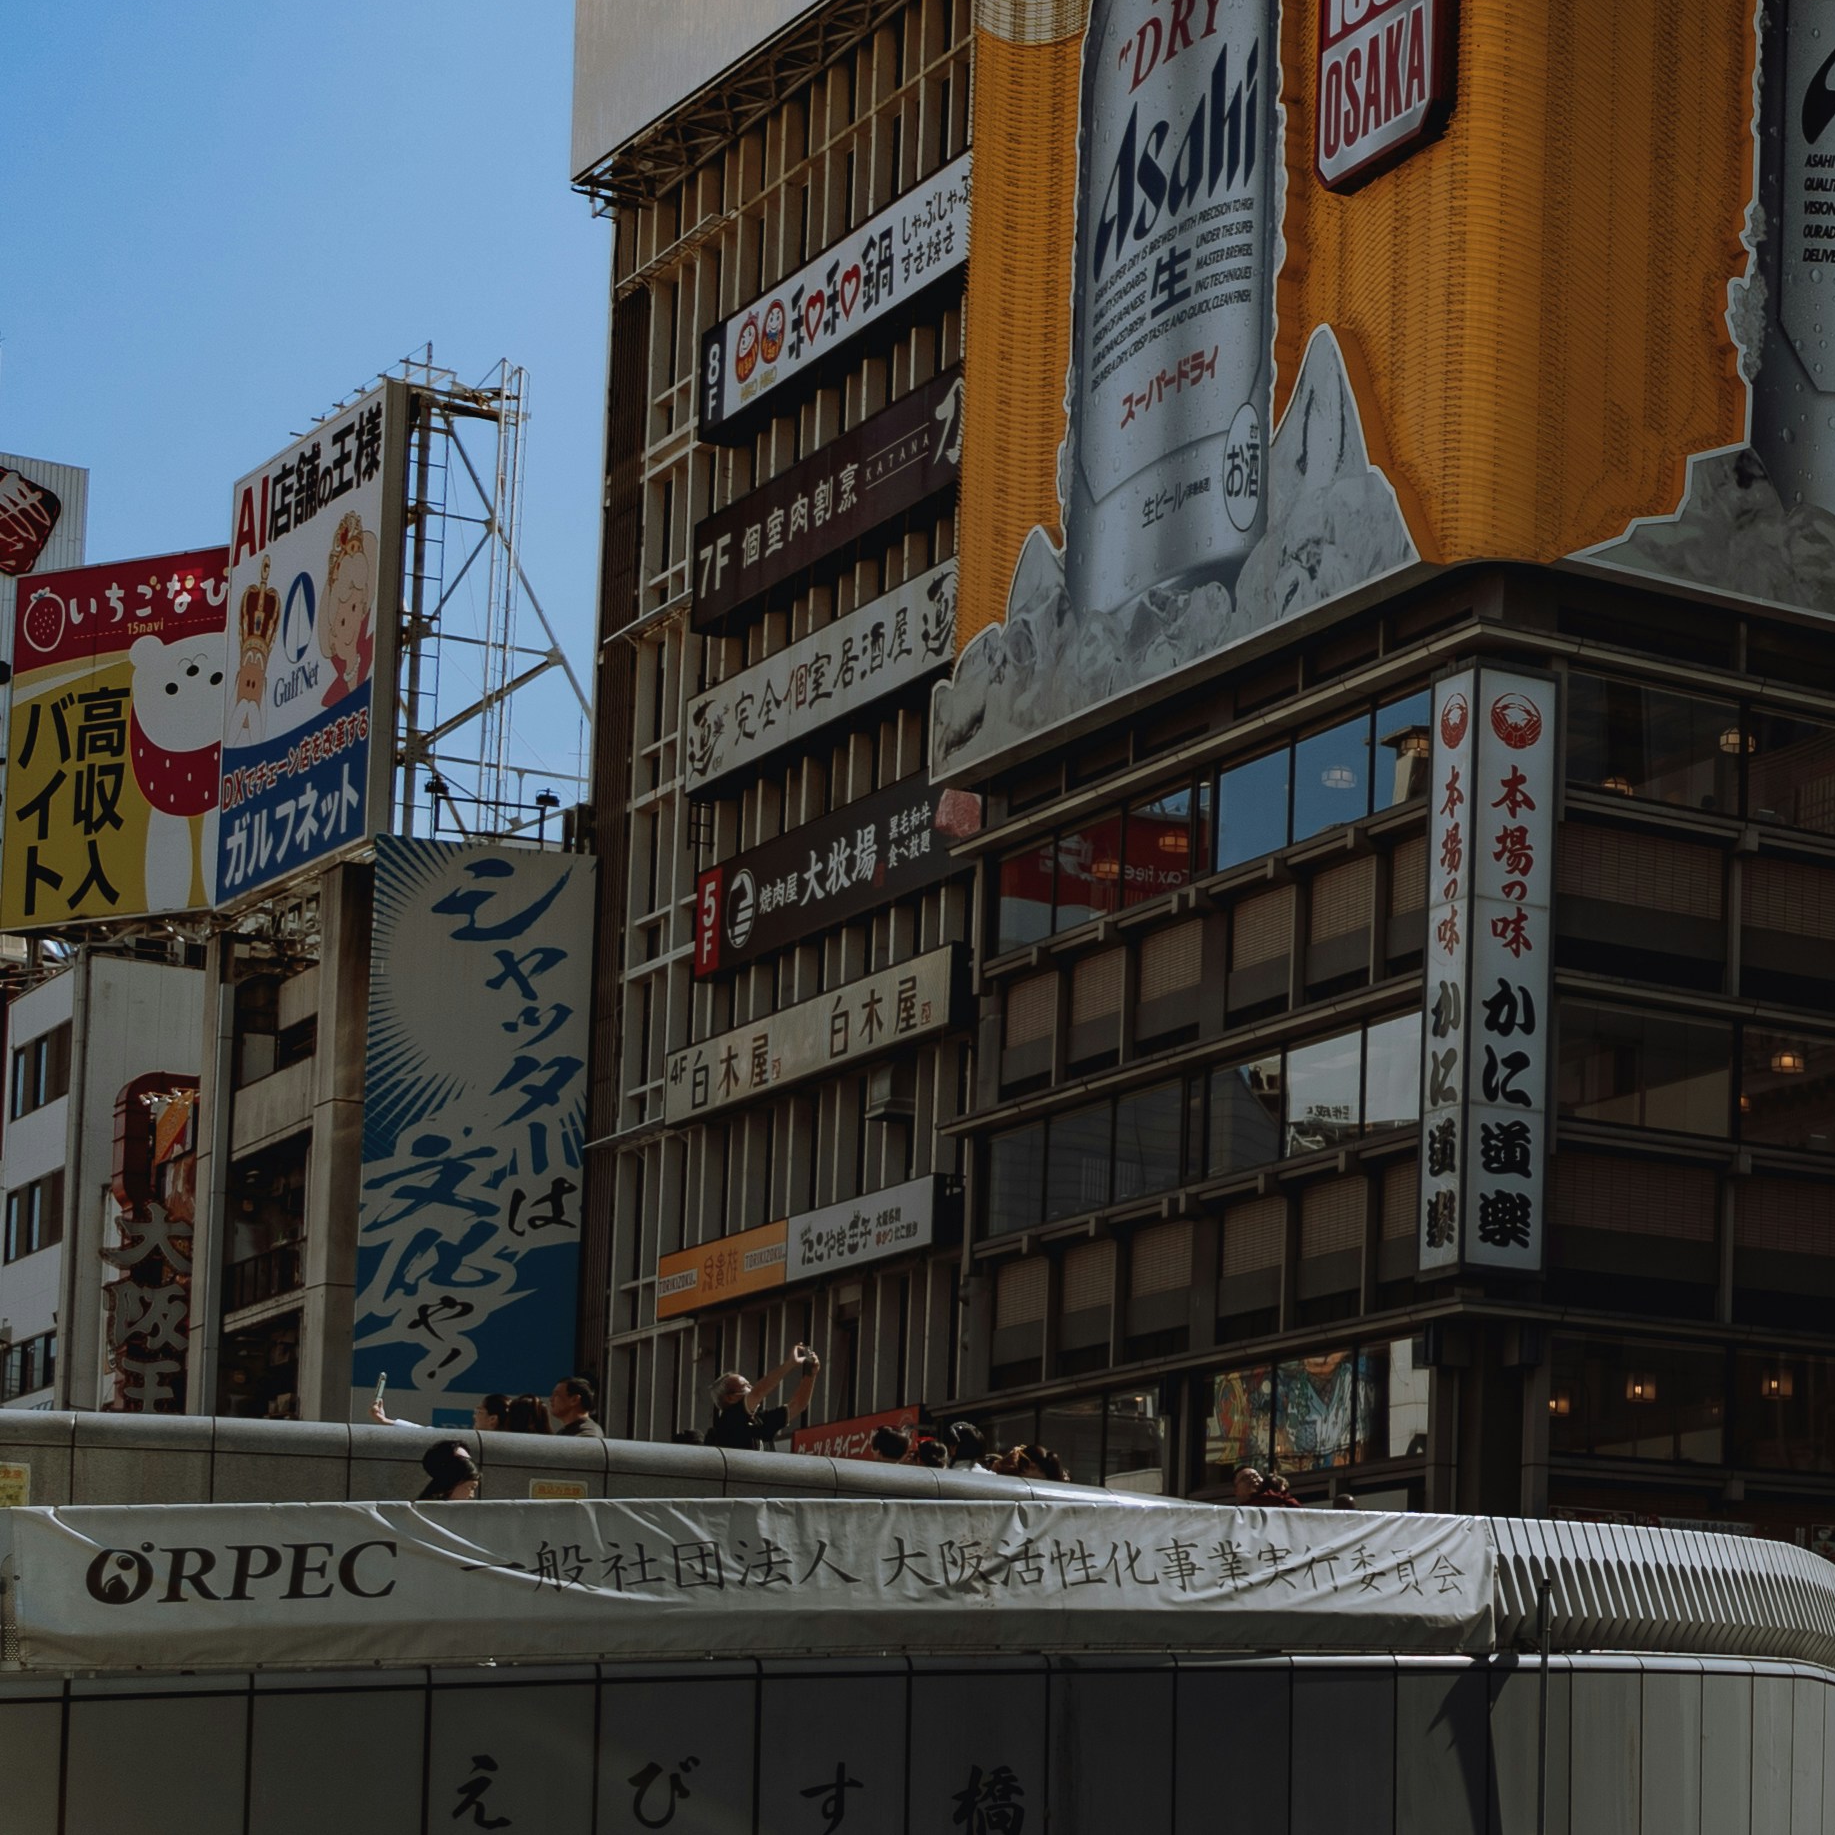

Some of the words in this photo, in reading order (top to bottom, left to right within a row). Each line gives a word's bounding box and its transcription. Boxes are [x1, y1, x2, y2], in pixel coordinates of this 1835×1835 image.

[1323, 0, 1426, 160] OSAKA
[1094, 37, 1259, 283] Asahi
[1805, 154, 1835, 167] ASAHI
[902, 221, 954, 283] すき焼き
[1150, 245, 1191, 320] 生
[706, 343, 721, 420] 8F
[1120, 345, 1219, 429] スーパードライ
[235, 401, 382, 566] AI店舗の王様
[865, 433, 930, 482] KATANA
[700, 533, 731, 599] 7F
[742, 463, 859, 569] 個室肉割烹
[127, 617, 165, 636] 15navi
[274, 668, 302, 708] Gulf
[300, 661, 319, 694] Net
[734, 606, 912, 747] 完全個室居酒屋
[16, 704, 74, 915] バイト
[69, 687, 130, 909] 高収入
[222, 706, 368, 813] DXでチェーン店を改革する
[224, 763, 359, 889] ガルフネット
[888, 801, 932, 841] 黒毛和牛
[888, 828, 932, 869] 食べ放題
[1437, 765, 1465, 956] 本場の味
[1490, 764, 1536, 958] 本場の味
[702, 881, 716, 964] 5F
[759, 872, 798, 915] 焼肉屋
[800, 823, 877, 907] 大牧場
[432, 858, 585, 1236] シャッターは
[670, 1055, 687, 1086] 4F
[692, 1033, 769, 1109] 白木屋
[830, 975, 917, 1059] 白木屋
[1427, 980, 1461, 1249] かに道楽
[1479, 978, 1535, 1249] かに道楽
[101, 1202, 193, 1414] 大阪王
[461, 1537, 861, 1594] 一般社団法人
[883, 1536, 1466, 1598] 大阪活性化事業実行委員会
[451, 1755, 1025, 1835] えびす橋
